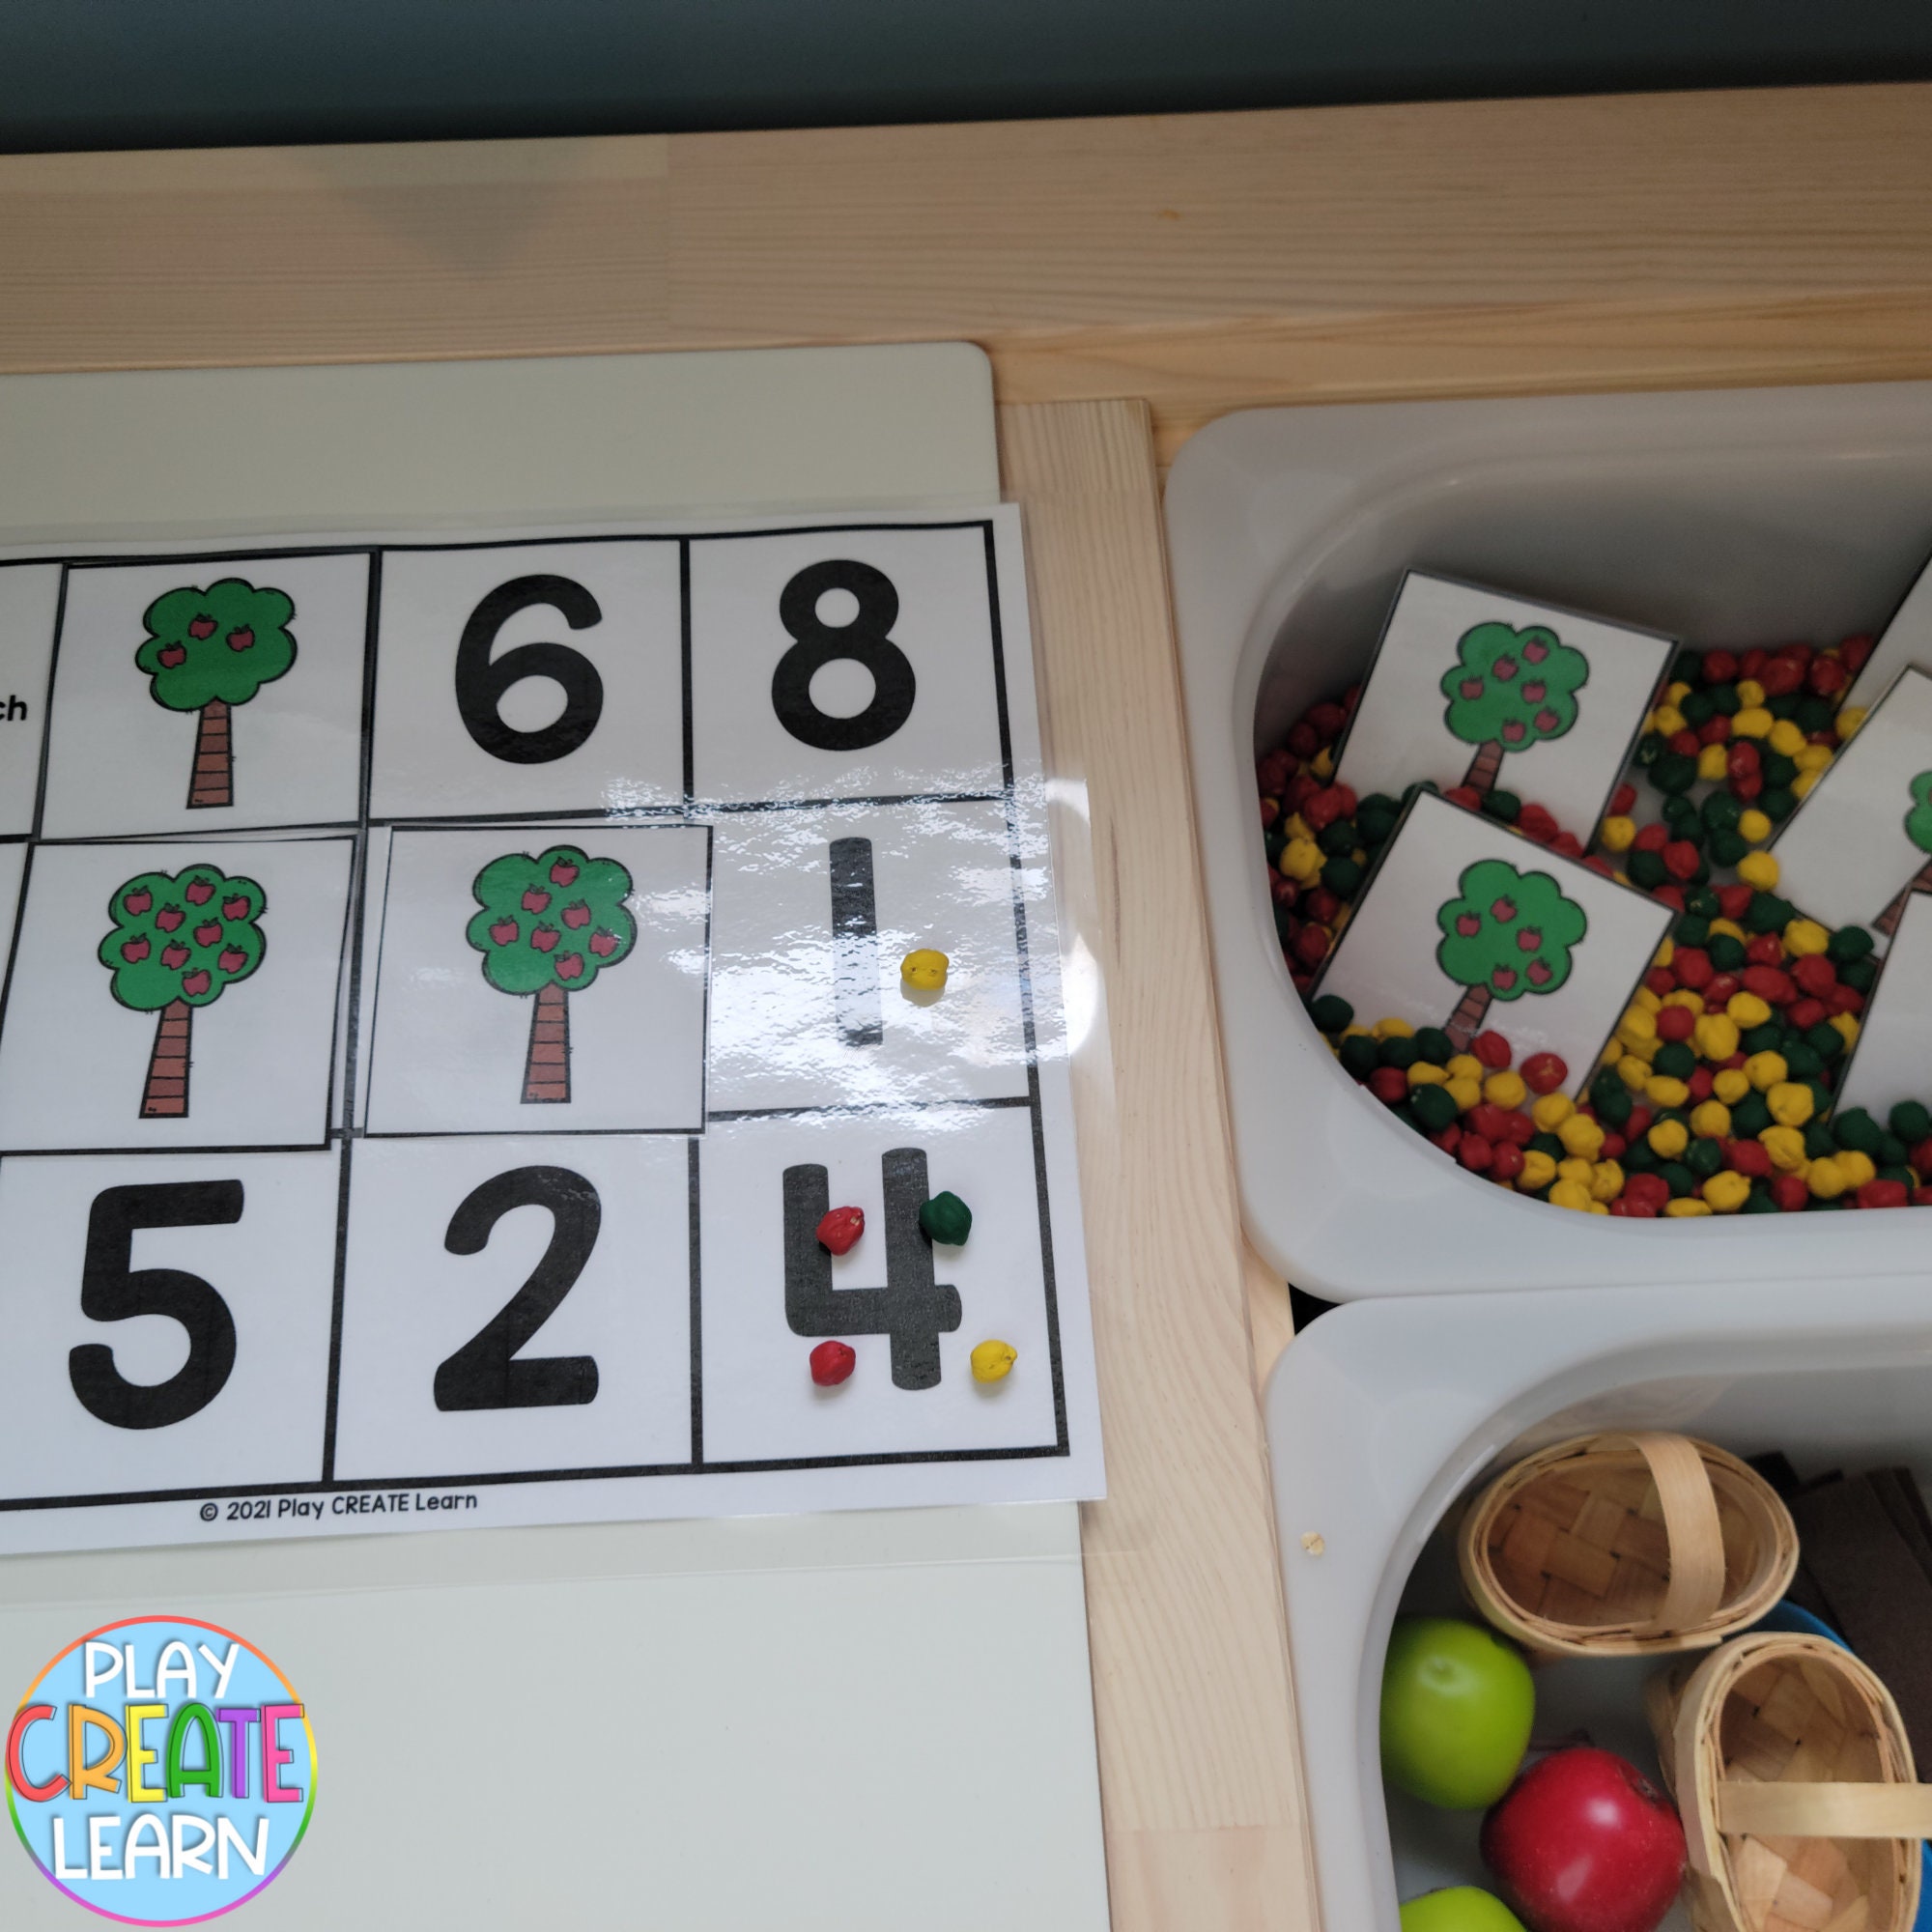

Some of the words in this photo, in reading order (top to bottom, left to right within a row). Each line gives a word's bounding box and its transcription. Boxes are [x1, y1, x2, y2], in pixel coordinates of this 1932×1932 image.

[454, 574, 604, 764] 6
[771, 559, 917, 752] 8
[69, 1179, 244, 1431] 5
[433, 1165, 602, 1412] 2
[782, 1148, 963, 1390] 4
[226, 1500, 271, 1520] 2021
[277, 1498, 325, 1520] Play
[331, 1493, 411, 1515] CREATE
[415, 1492, 478, 1512] Learn
